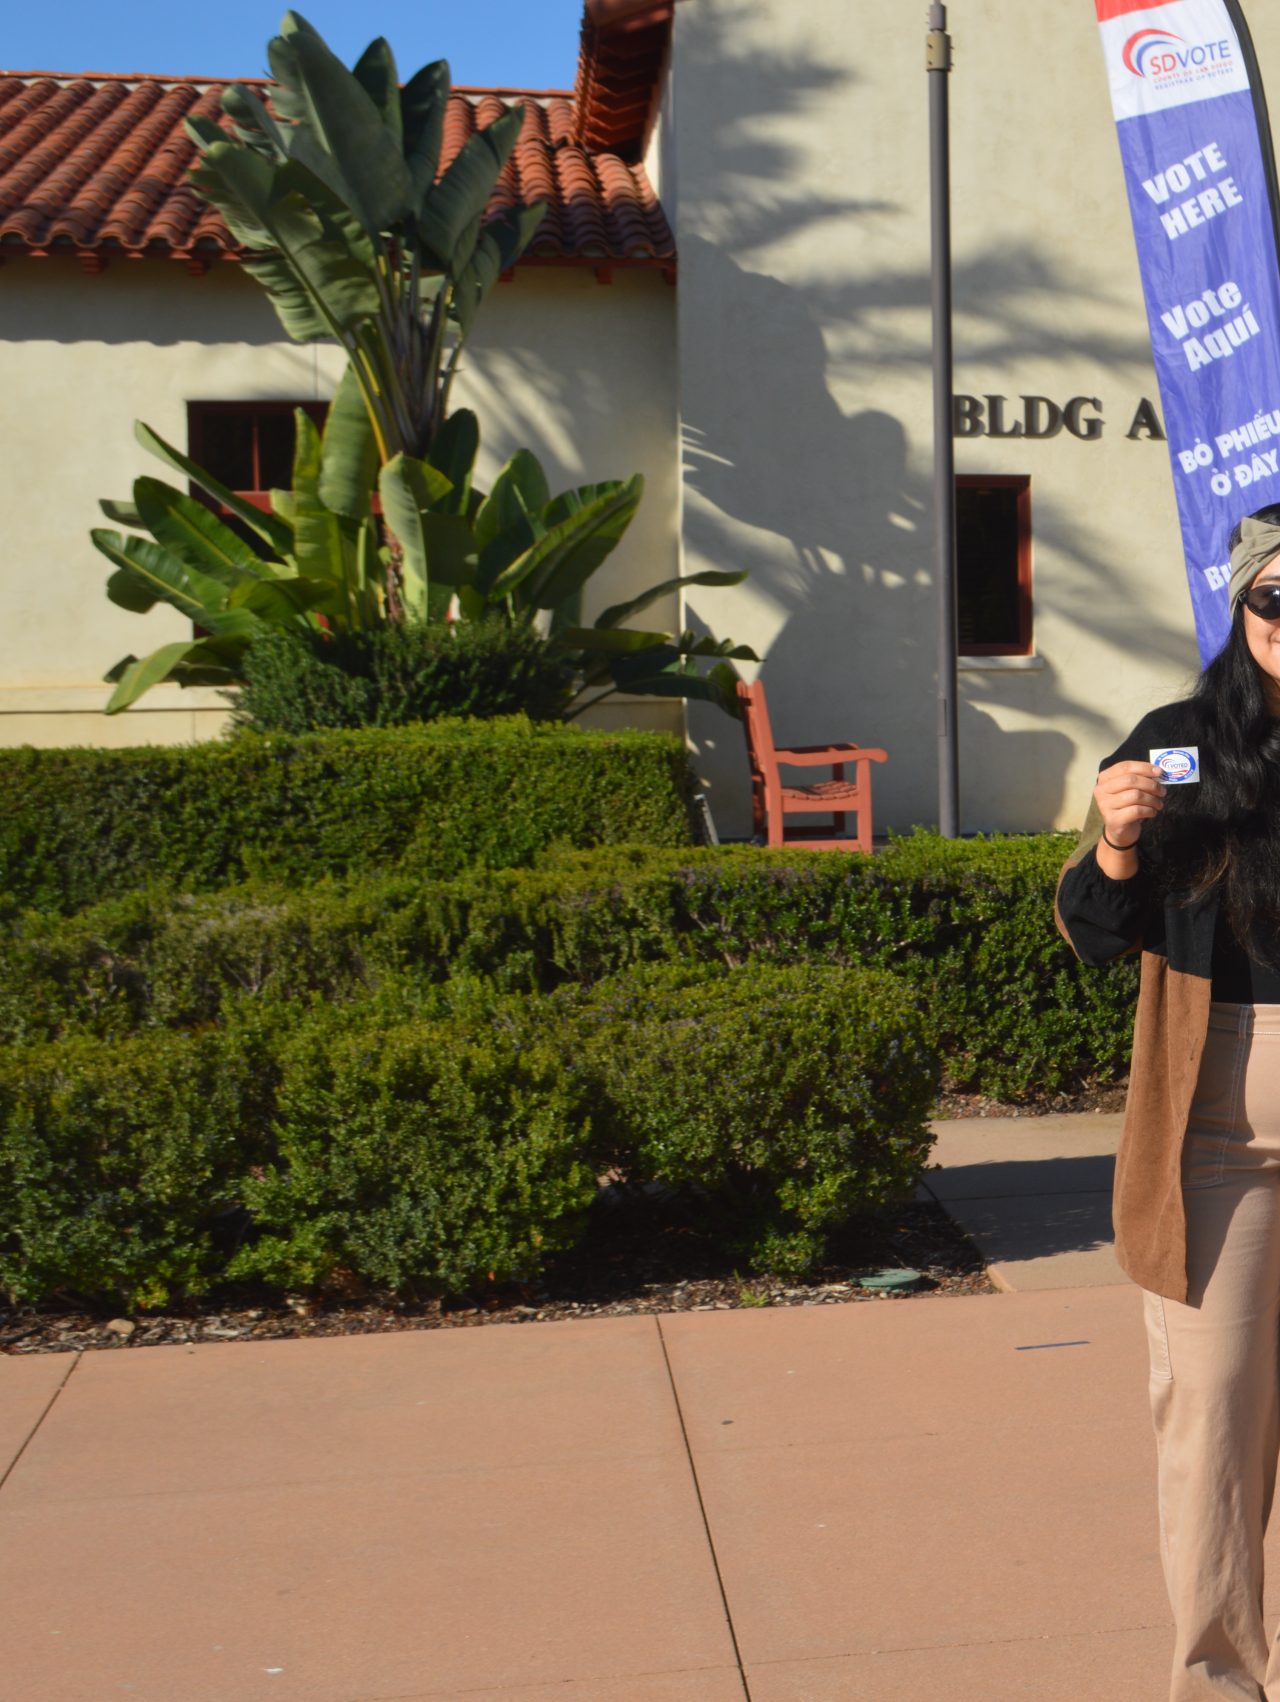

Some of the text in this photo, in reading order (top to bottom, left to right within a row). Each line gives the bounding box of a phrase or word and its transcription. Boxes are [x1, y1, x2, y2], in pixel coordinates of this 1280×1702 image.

[1150, 39, 1231, 76] SDVOTE
[1141, 141, 1227, 206] VOTE
[1159, 176, 1243, 241] HERE
[1160, 280, 1242, 341] Vote
[1182, 303, 1260, 372] Aquí
[952, 394, 1168, 441] BLDG A
